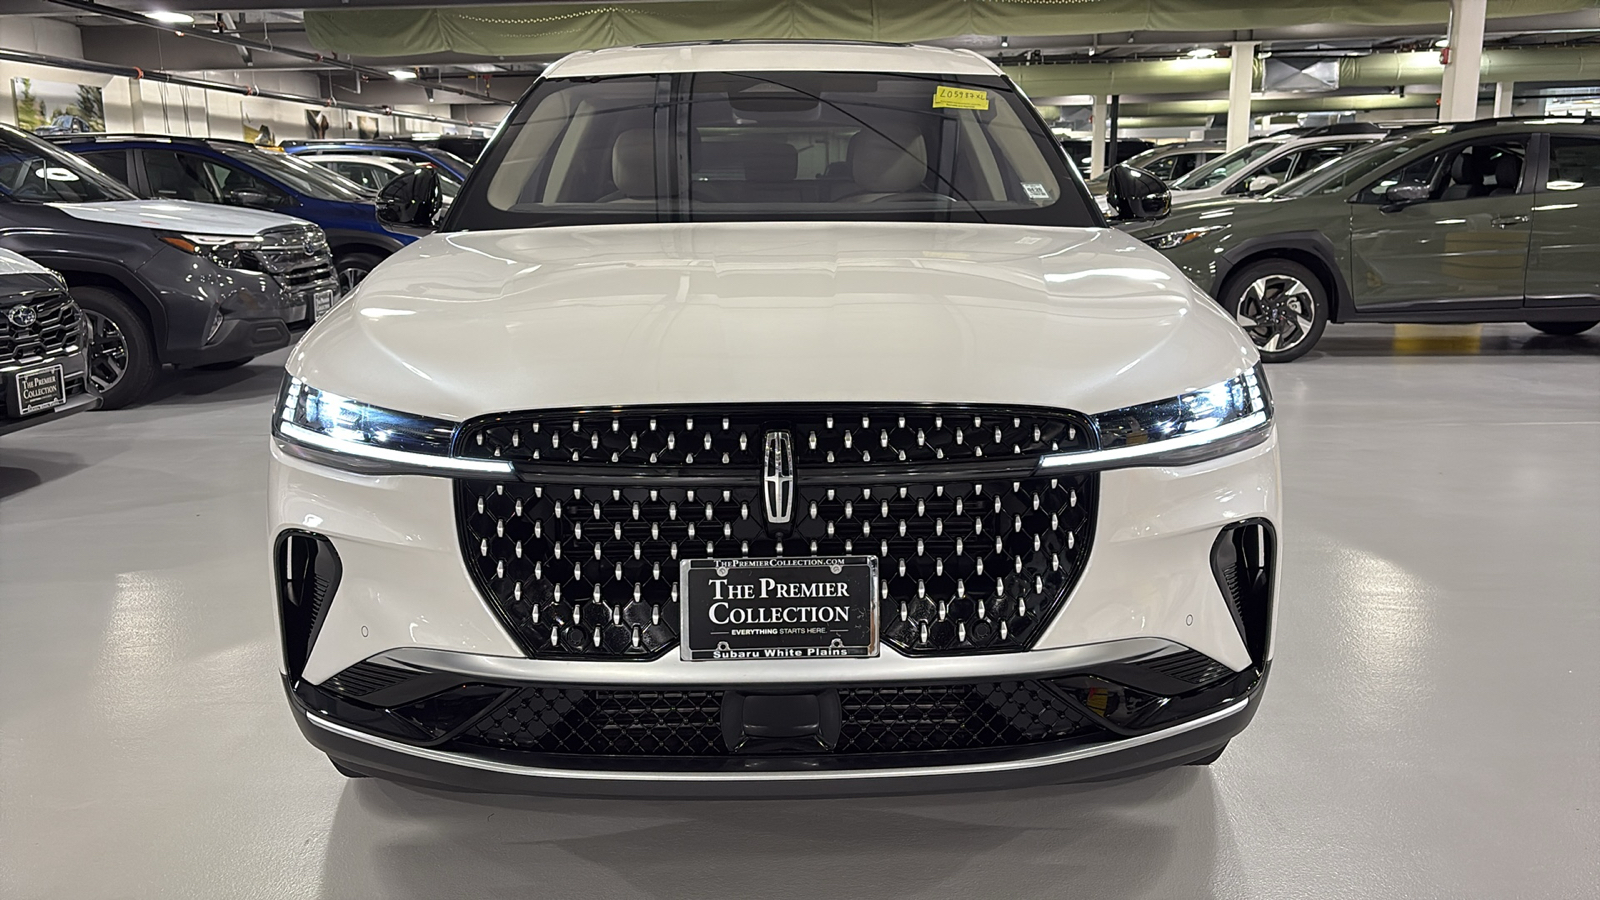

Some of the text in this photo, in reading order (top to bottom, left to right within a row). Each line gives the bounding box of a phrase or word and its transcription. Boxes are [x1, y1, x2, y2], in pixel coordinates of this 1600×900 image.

[708, 577, 850, 600] THE PREMIER
[708, 601, 850, 624] COLLECTION
[764, 649, 803, 657] White
[807, 648, 848, 656] Plains
